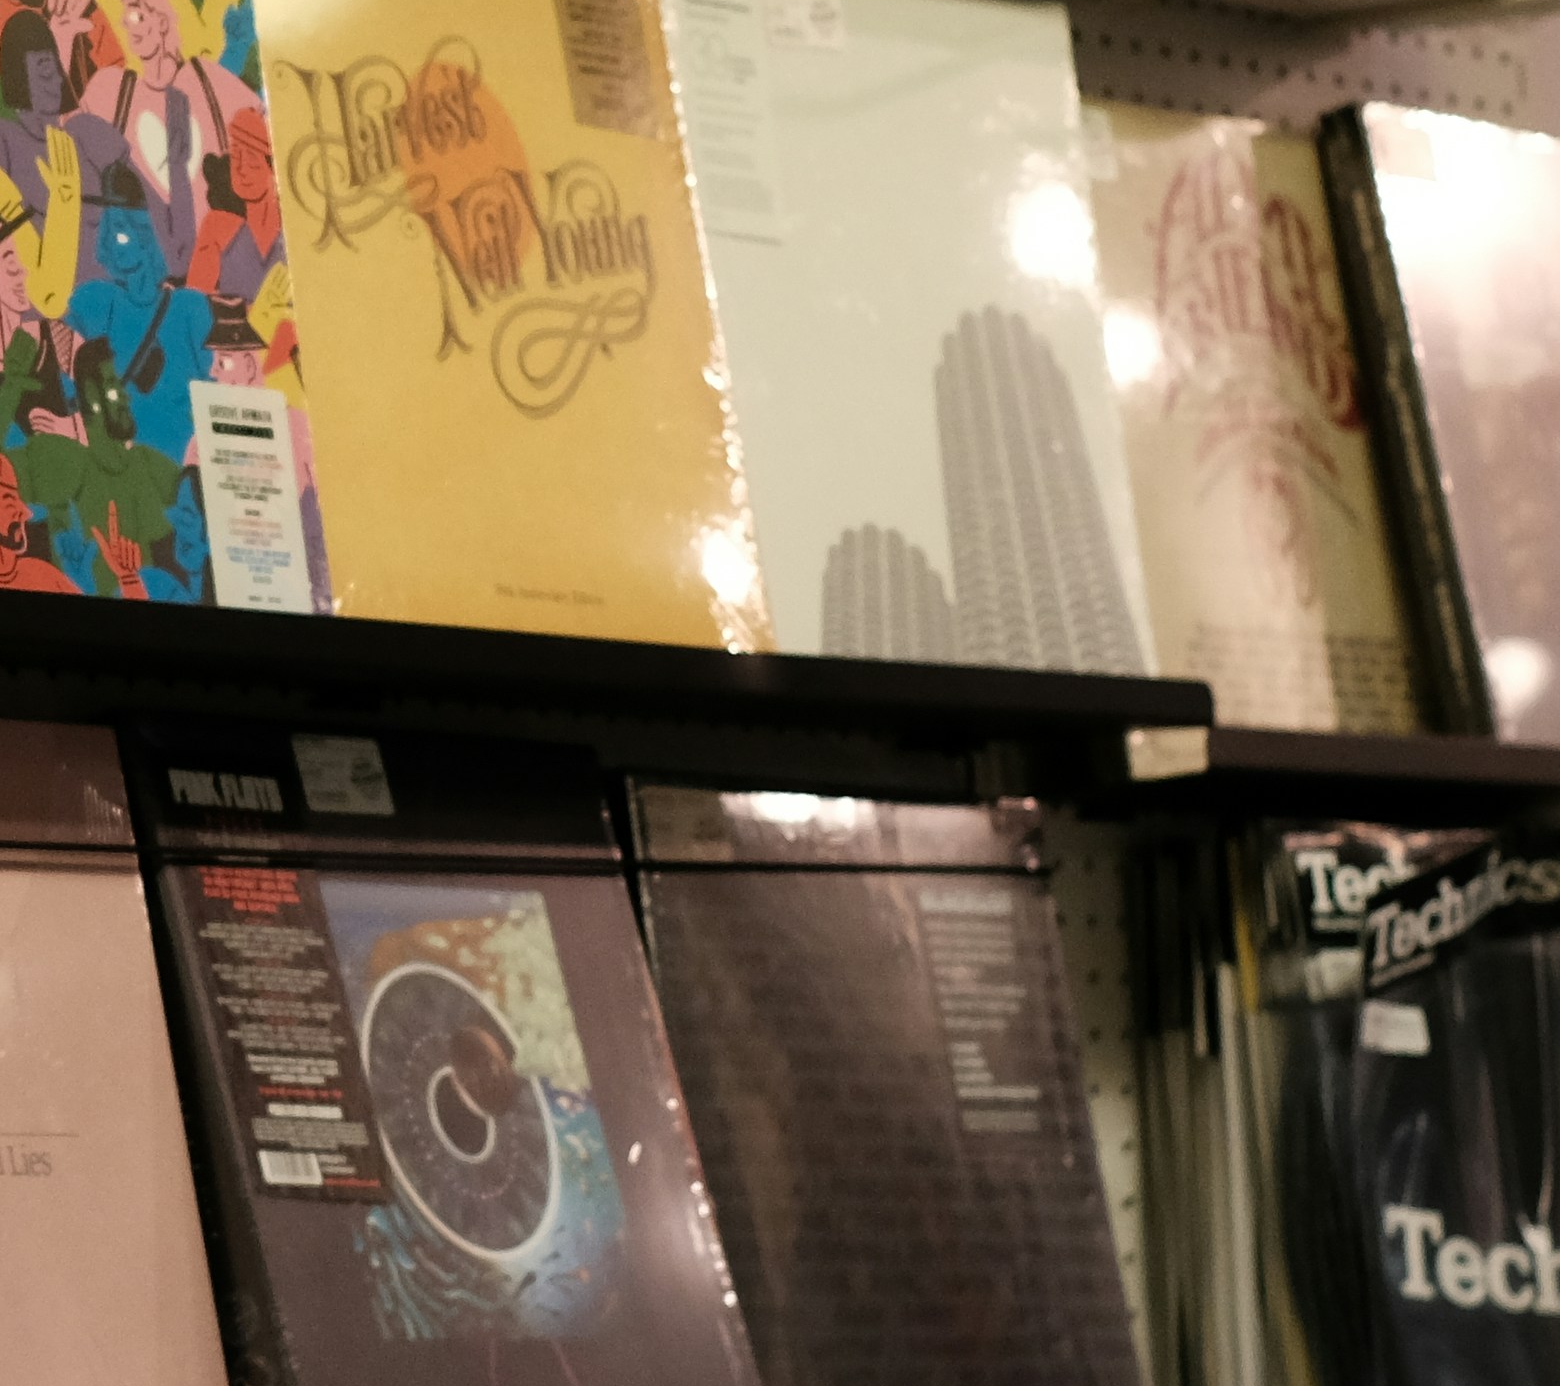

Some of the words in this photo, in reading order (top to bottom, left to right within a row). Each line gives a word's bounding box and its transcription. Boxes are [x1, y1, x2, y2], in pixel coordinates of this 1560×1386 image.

[276, 35, 487, 253] Harvest
[404, 171, 526, 363] Neil
[492, 159, 657, 420] Young
[8, 1145, 52, 1178] Lies
